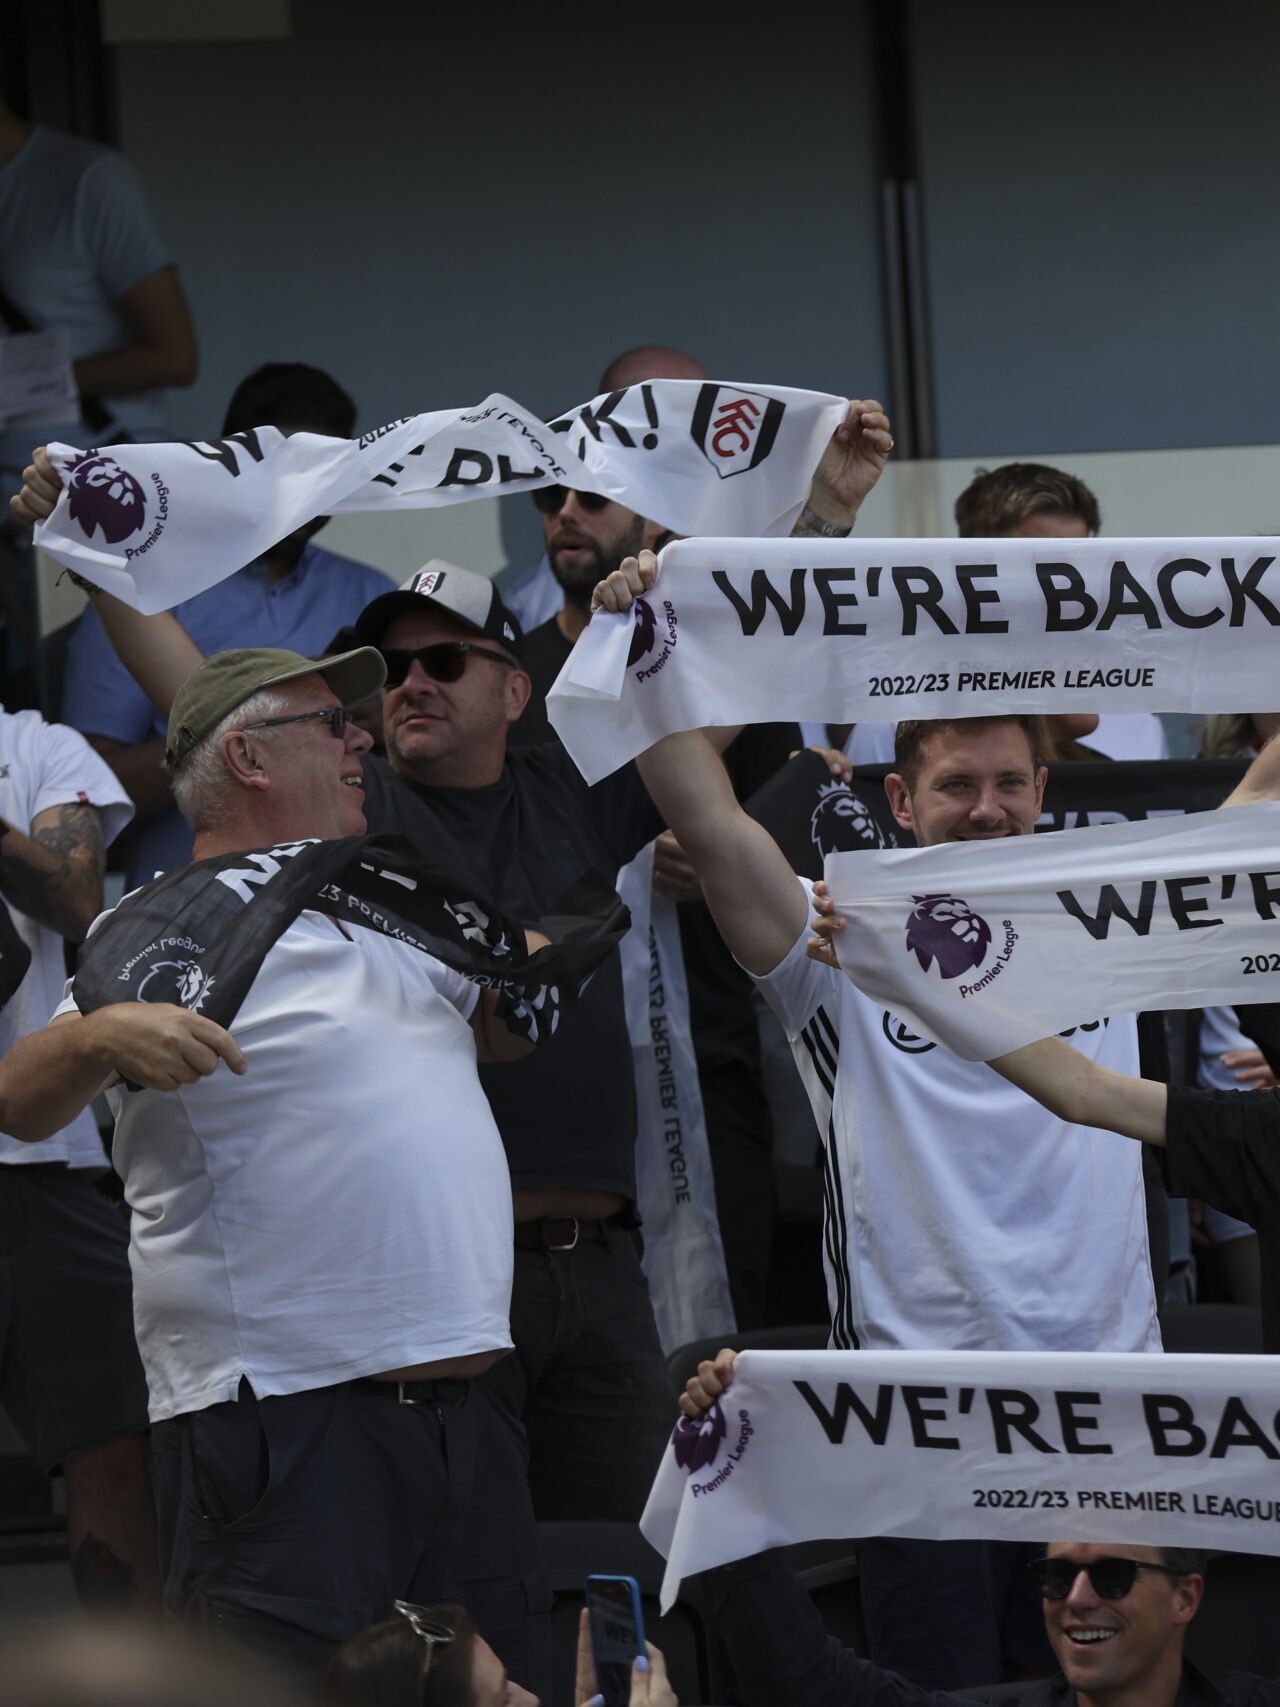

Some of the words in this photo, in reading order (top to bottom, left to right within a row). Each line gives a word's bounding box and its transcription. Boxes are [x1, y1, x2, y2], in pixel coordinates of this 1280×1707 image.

[712, 398, 761, 458] FFC
[125, 523, 164, 561] Premier
[149, 472, 170, 521] League
[711, 563, 1010, 637] WE'RE
[635, 645, 671, 684] Premier
[660, 599, 678, 648] League
[868, 672, 950, 697] 2022/23
[957, 670, 1056, 693] PREMIER
[1063, 667, 1156, 689] LEAGUE
[958, 960, 1005, 999] Premier
[996, 919, 1019, 962] League
[690, 1459, 735, 1499] Premier
[733, 1408, 754, 1461] League
[792, 1379, 1114, 1456] WE'RE
[972, 1489, 1070, 1509] 2022/23
[1077, 1490, 1186, 1514] PREMIER
